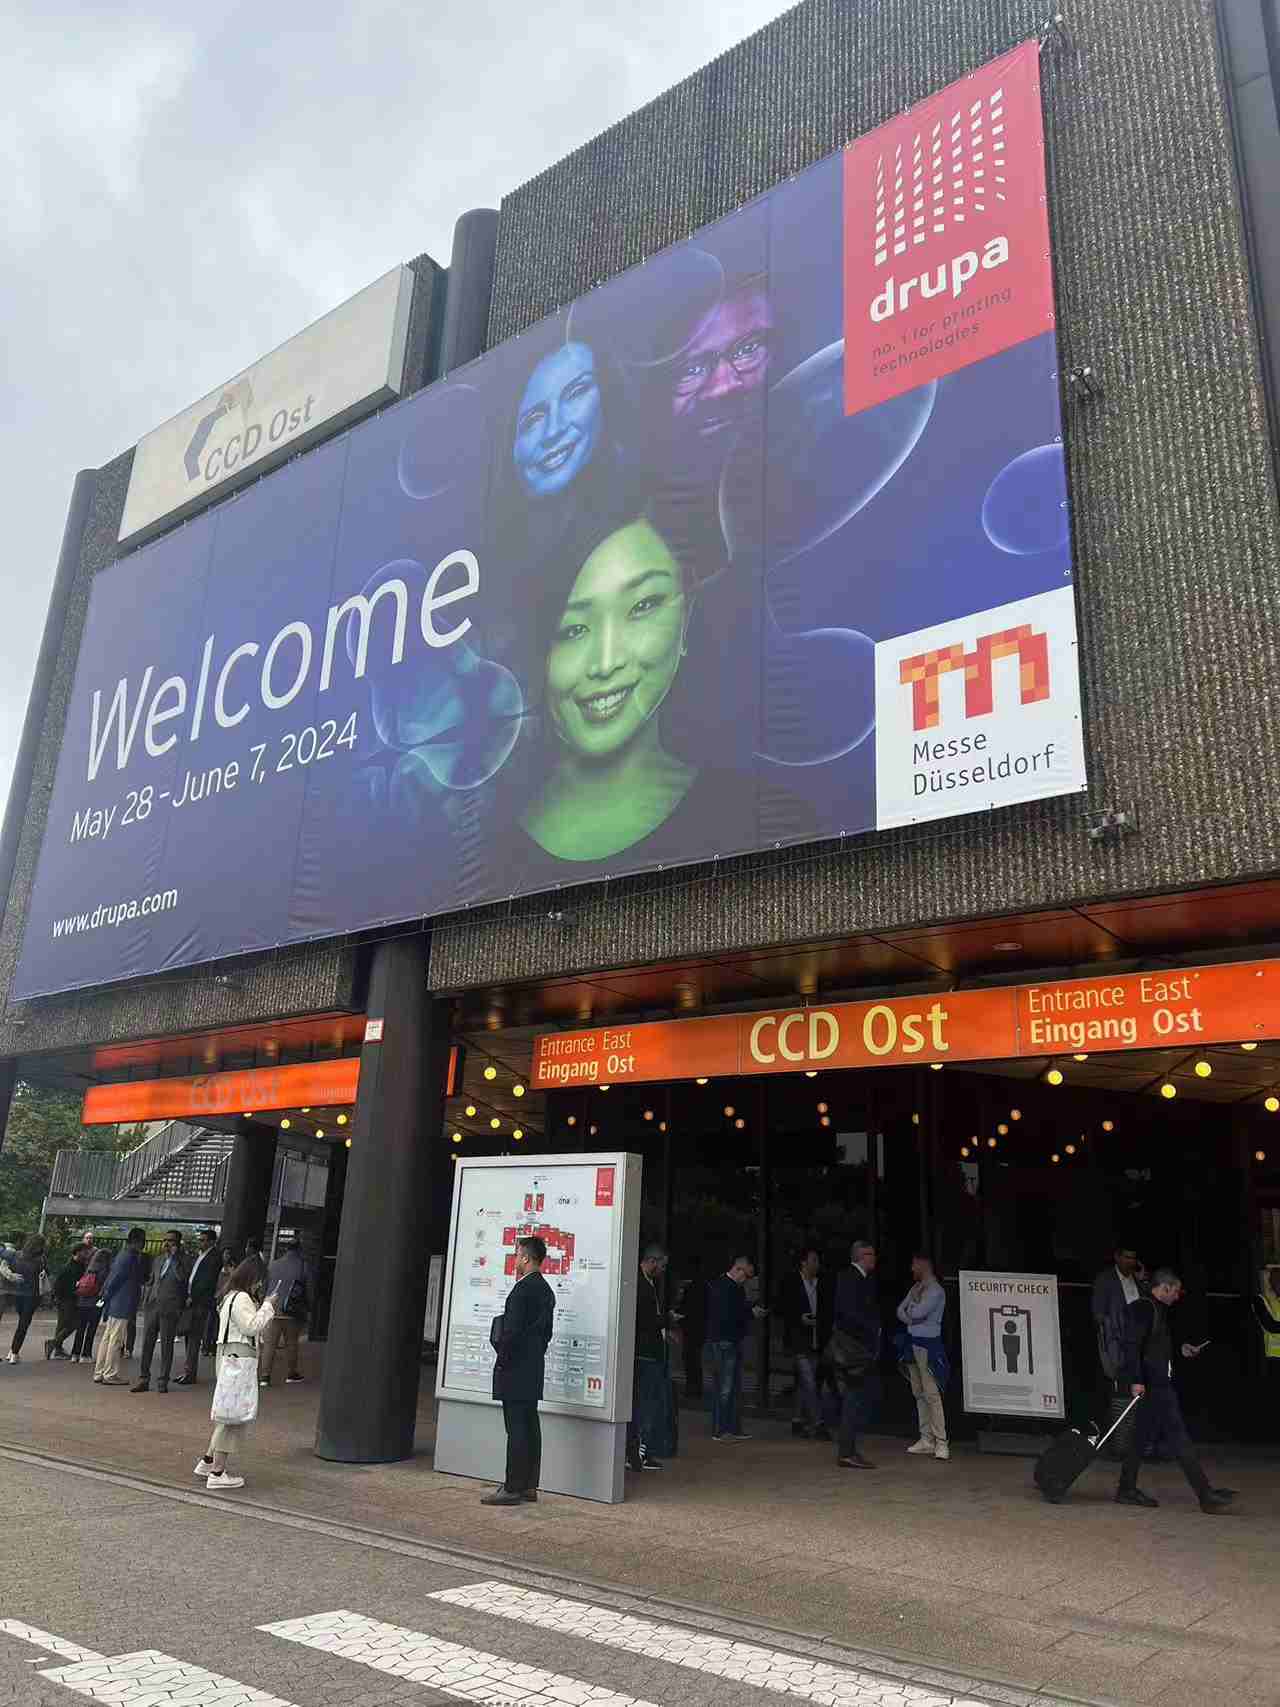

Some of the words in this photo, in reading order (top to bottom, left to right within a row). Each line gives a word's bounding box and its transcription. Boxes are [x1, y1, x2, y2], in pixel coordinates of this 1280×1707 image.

[869, 234, 1009, 322] drupa
[943, 287, 1011, 330] printing
[872, 321, 981, 377] technologies
[204, 422, 262, 482] CCD
[268, 393, 316, 443] Ost
[86, 548, 480, 782] Welcome
[912, 732, 988, 765] Messe
[912, 743, 1056, 797] Düsseldorf
[70, 803, 117, 842] May
[120, 785, 154, 827] 28
[172, 760, 239, 808] June
[249, 743, 267, 784] 7,
[276, 711, 359, 773] 2024
[52, 887, 178, 938] www.drupa.com
[1028, 985, 1126, 1014] Entrance
[1139, 975, 1194, 1004] East
[540, 1033, 596, 1058] Entrance
[602, 1030, 633, 1051] East
[749, 1010, 840, 1064] CCD
[862, 1002, 950, 1056] Ost
[1030, 1016, 1138, 1048] Eingang
[1152, 1007, 1204, 1035] Ost
[538, 1059, 599, 1084] Eingang
[606, 1054, 635, 1074] Ost
[967, 1280, 1016, 1294] SECURITY
[1016, 1283, 1049, 1295] CHECK
